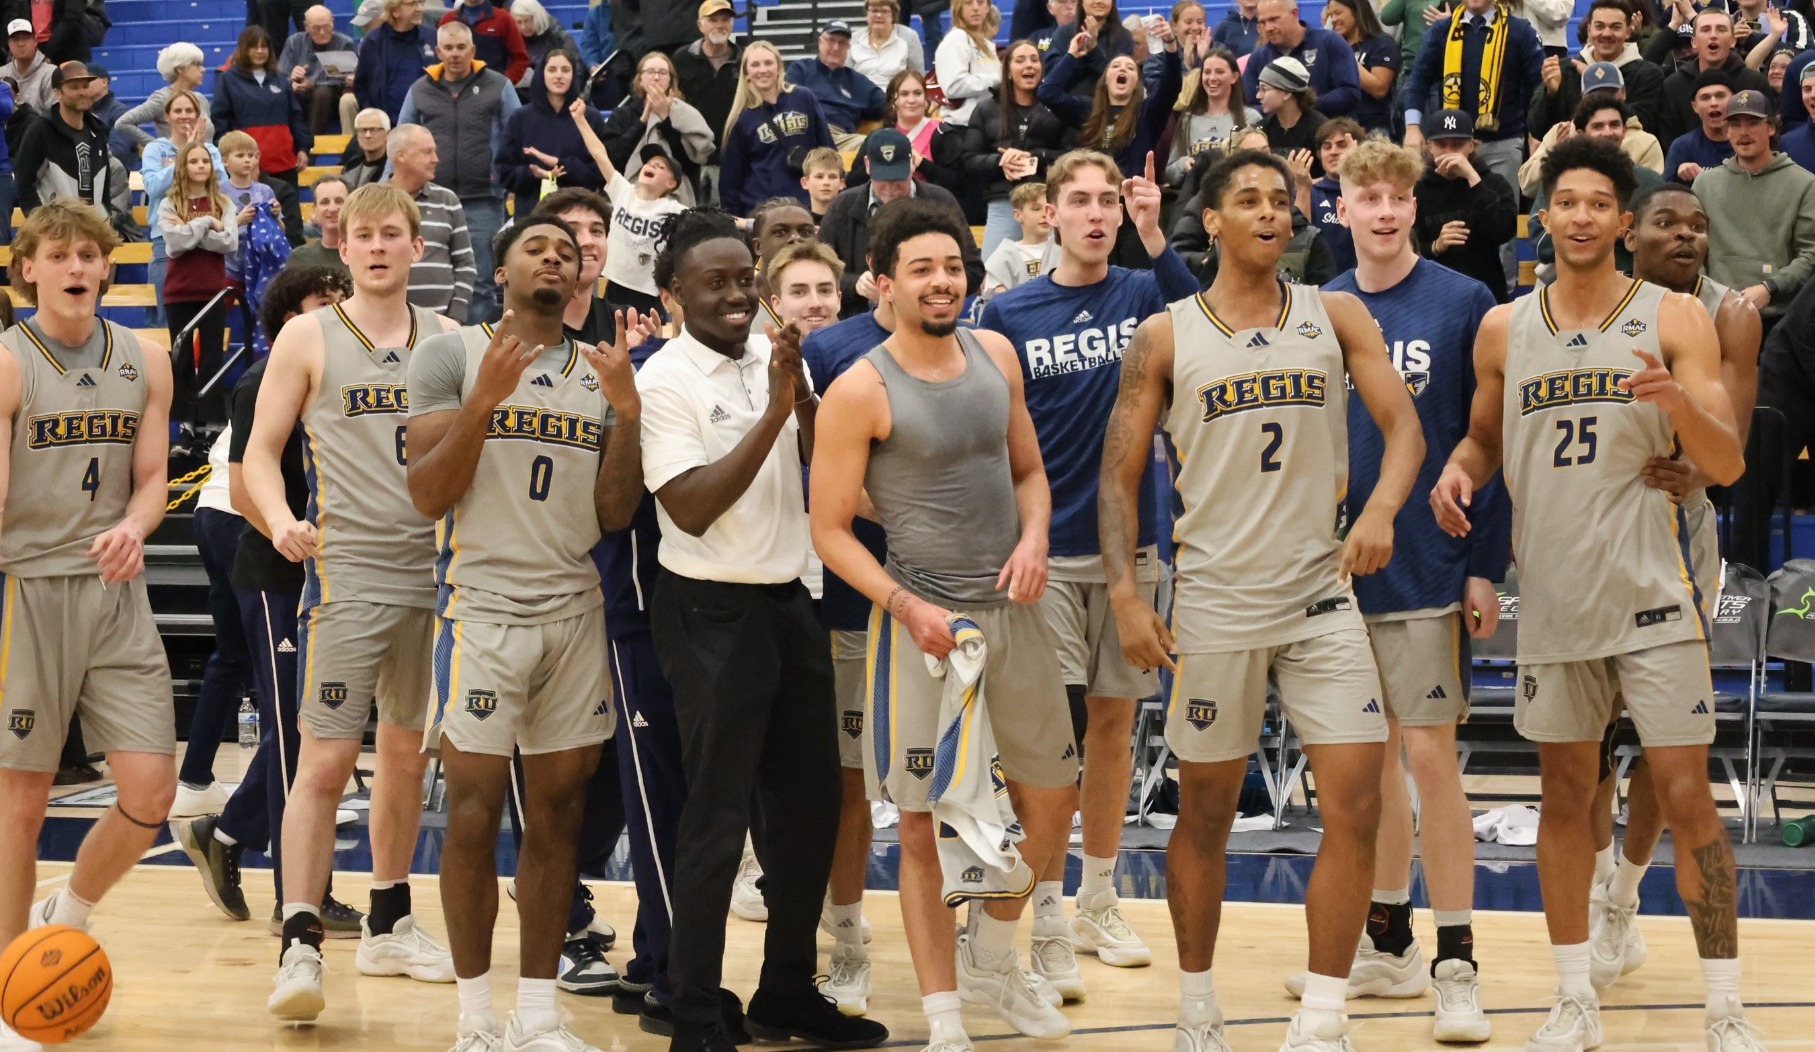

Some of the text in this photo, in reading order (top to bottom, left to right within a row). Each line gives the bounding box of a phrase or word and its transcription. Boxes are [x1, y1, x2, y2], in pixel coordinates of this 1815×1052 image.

[1443, 115, 1457, 130] NY
[615, 207, 661, 238] REGIS
[1025, 317, 1138, 379] REGIS
[1622, 324, 1646, 333] RMAC
[1033, 350, 1123, 379] BASKETBALL
[341, 384, 408, 418] REG
[1196, 367, 1327, 423] REGIS
[1516, 367, 1640, 416] REGIS
[28, 408, 139, 450] REGIS
[486, 403, 601, 453] REGIS
[1260, 421, 1283, 473] 2
[1553, 416, 1598, 468] 25
[81, 457, 100, 502] 4
[529, 455, 554, 501] 0
[36, 966, 105, 1021] Wilson
